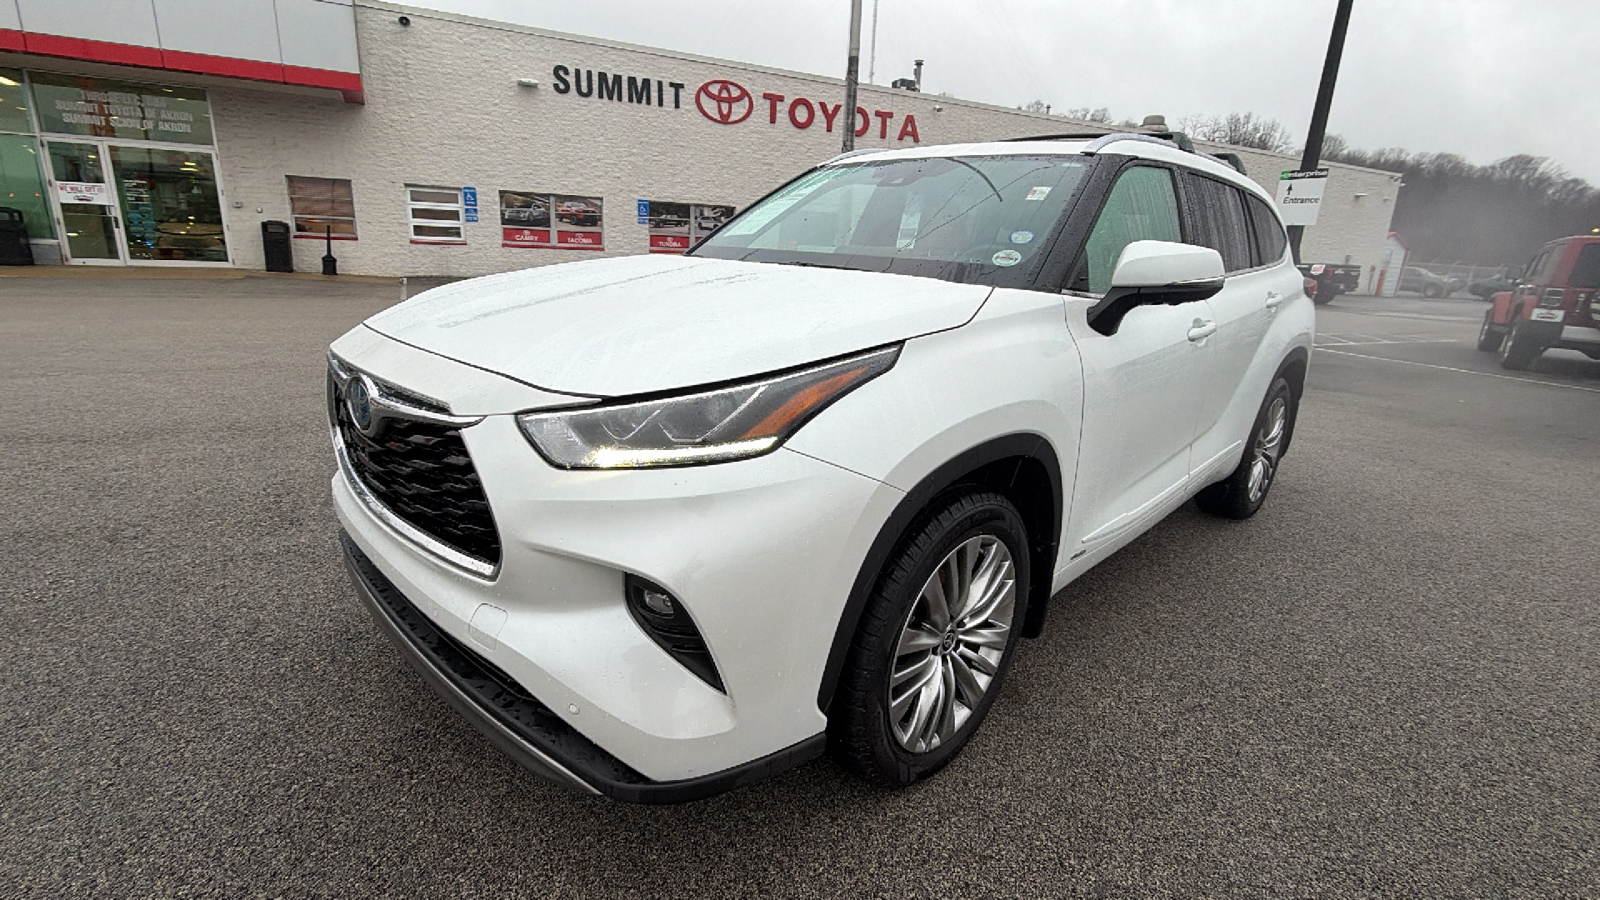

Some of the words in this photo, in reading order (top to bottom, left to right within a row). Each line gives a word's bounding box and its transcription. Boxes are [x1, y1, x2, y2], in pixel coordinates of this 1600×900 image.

[553, 65, 685, 109] SUMMIT
[763, 92, 920, 143] TOYOTA
[160, 109, 193, 122] AKRON
[62, 112, 106, 126] SUMMIT
[158, 121, 192, 133] AKRON
[1281, 170, 1328, 178] enterprise
[1283, 196, 1320, 204] Entrance
